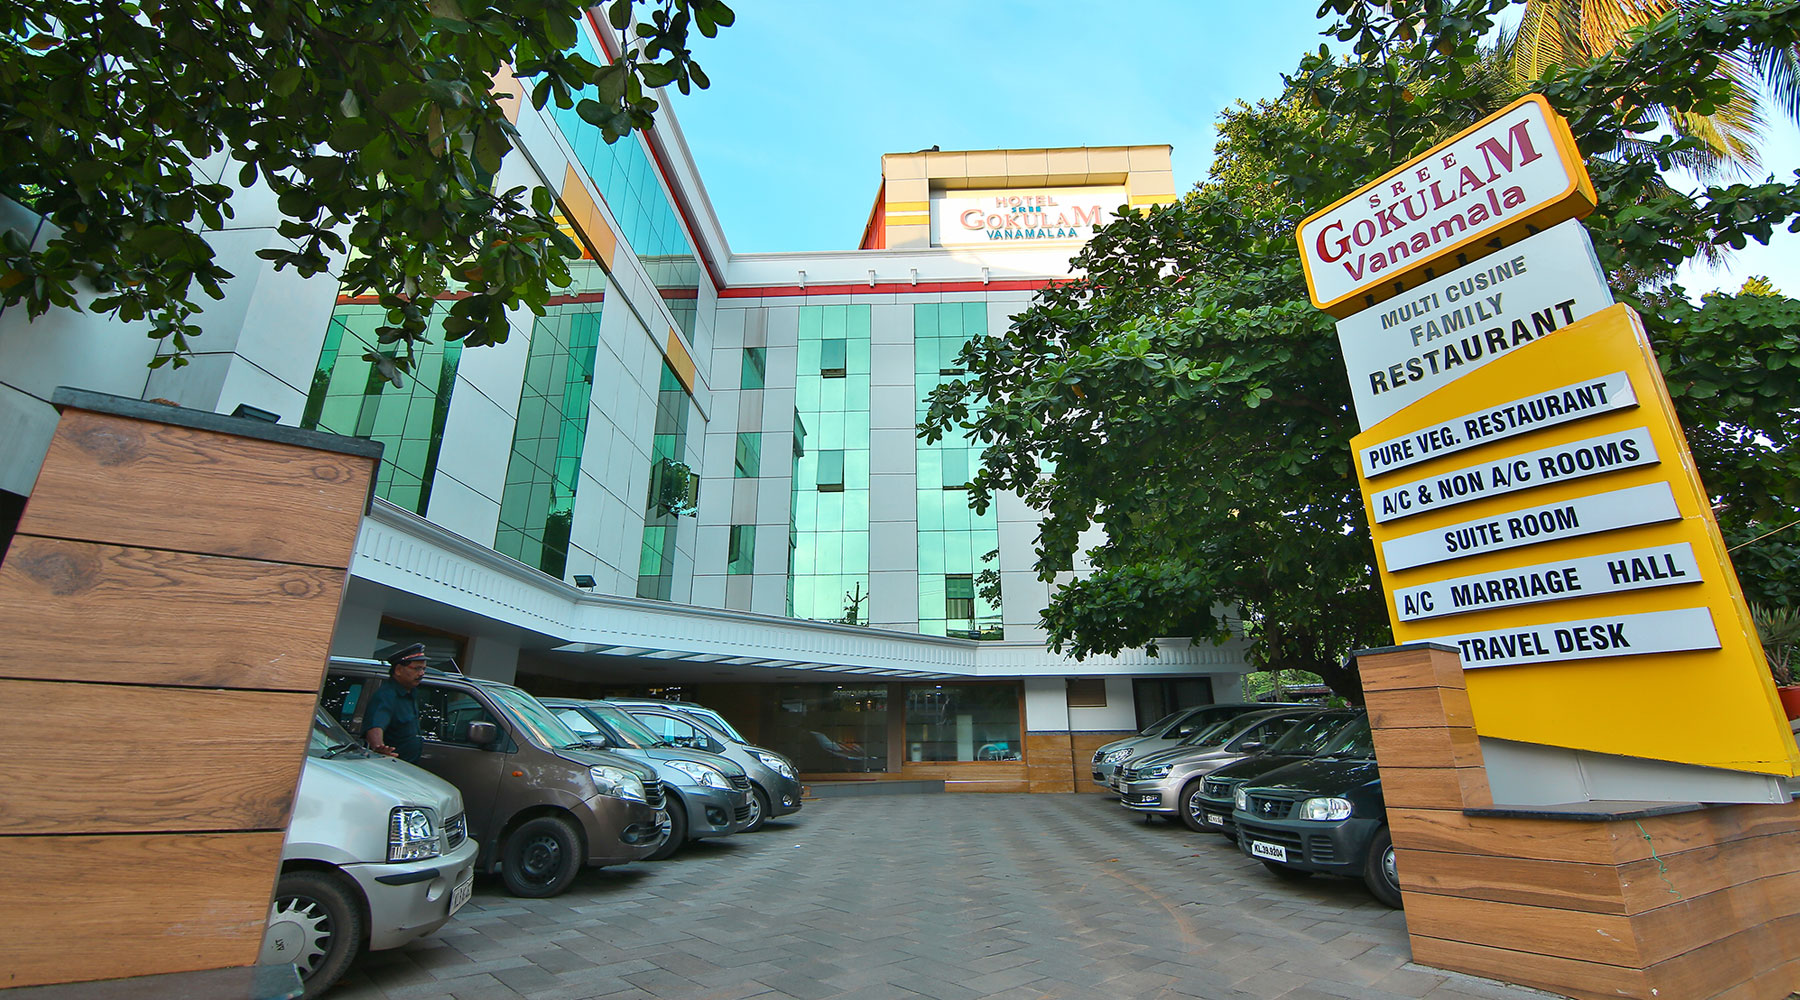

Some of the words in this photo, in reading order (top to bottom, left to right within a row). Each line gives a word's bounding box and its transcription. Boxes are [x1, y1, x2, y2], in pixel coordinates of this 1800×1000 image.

[996, 195, 1058, 208] HOTEL
[1316, 118, 1543, 264] GOKULAM
[1368, 152, 1456, 208] SREE
[960, 205, 1103, 231] GOKULAM
[986, 227, 1079, 241] VANAMALAA
[1342, 185, 1527, 282] Vanamala
[1380, 293, 1441, 330] MULTI
[1444, 255, 1527, 302] CUSINE
[1410, 293, 1504, 348] FAMILY
[1369, 299, 1578, 396] RESTAURANT
[1368, 439, 1412, 469] PURE
[1416, 426, 1461, 454] VEG.
[1464, 382, 1609, 441] RESTAURANT
[1382, 489, 1411, 515] A/C
[1417, 484, 1433, 505] &
[1438, 471, 1482, 500] NON
[1491, 460, 1531, 488] A/C
[1540, 438, 1641, 479] ROOMS
[1444, 522, 1504, 553] SUITE
[1509, 506, 1580, 540] ROOM
[1404, 590, 1434, 616] A/C
[1450, 567, 1582, 609] MARRIAGE
[1606, 553, 1686, 585] HALL
[1457, 631, 1549, 663] TRAVEL
[1553, 622, 1631, 654] DESK
